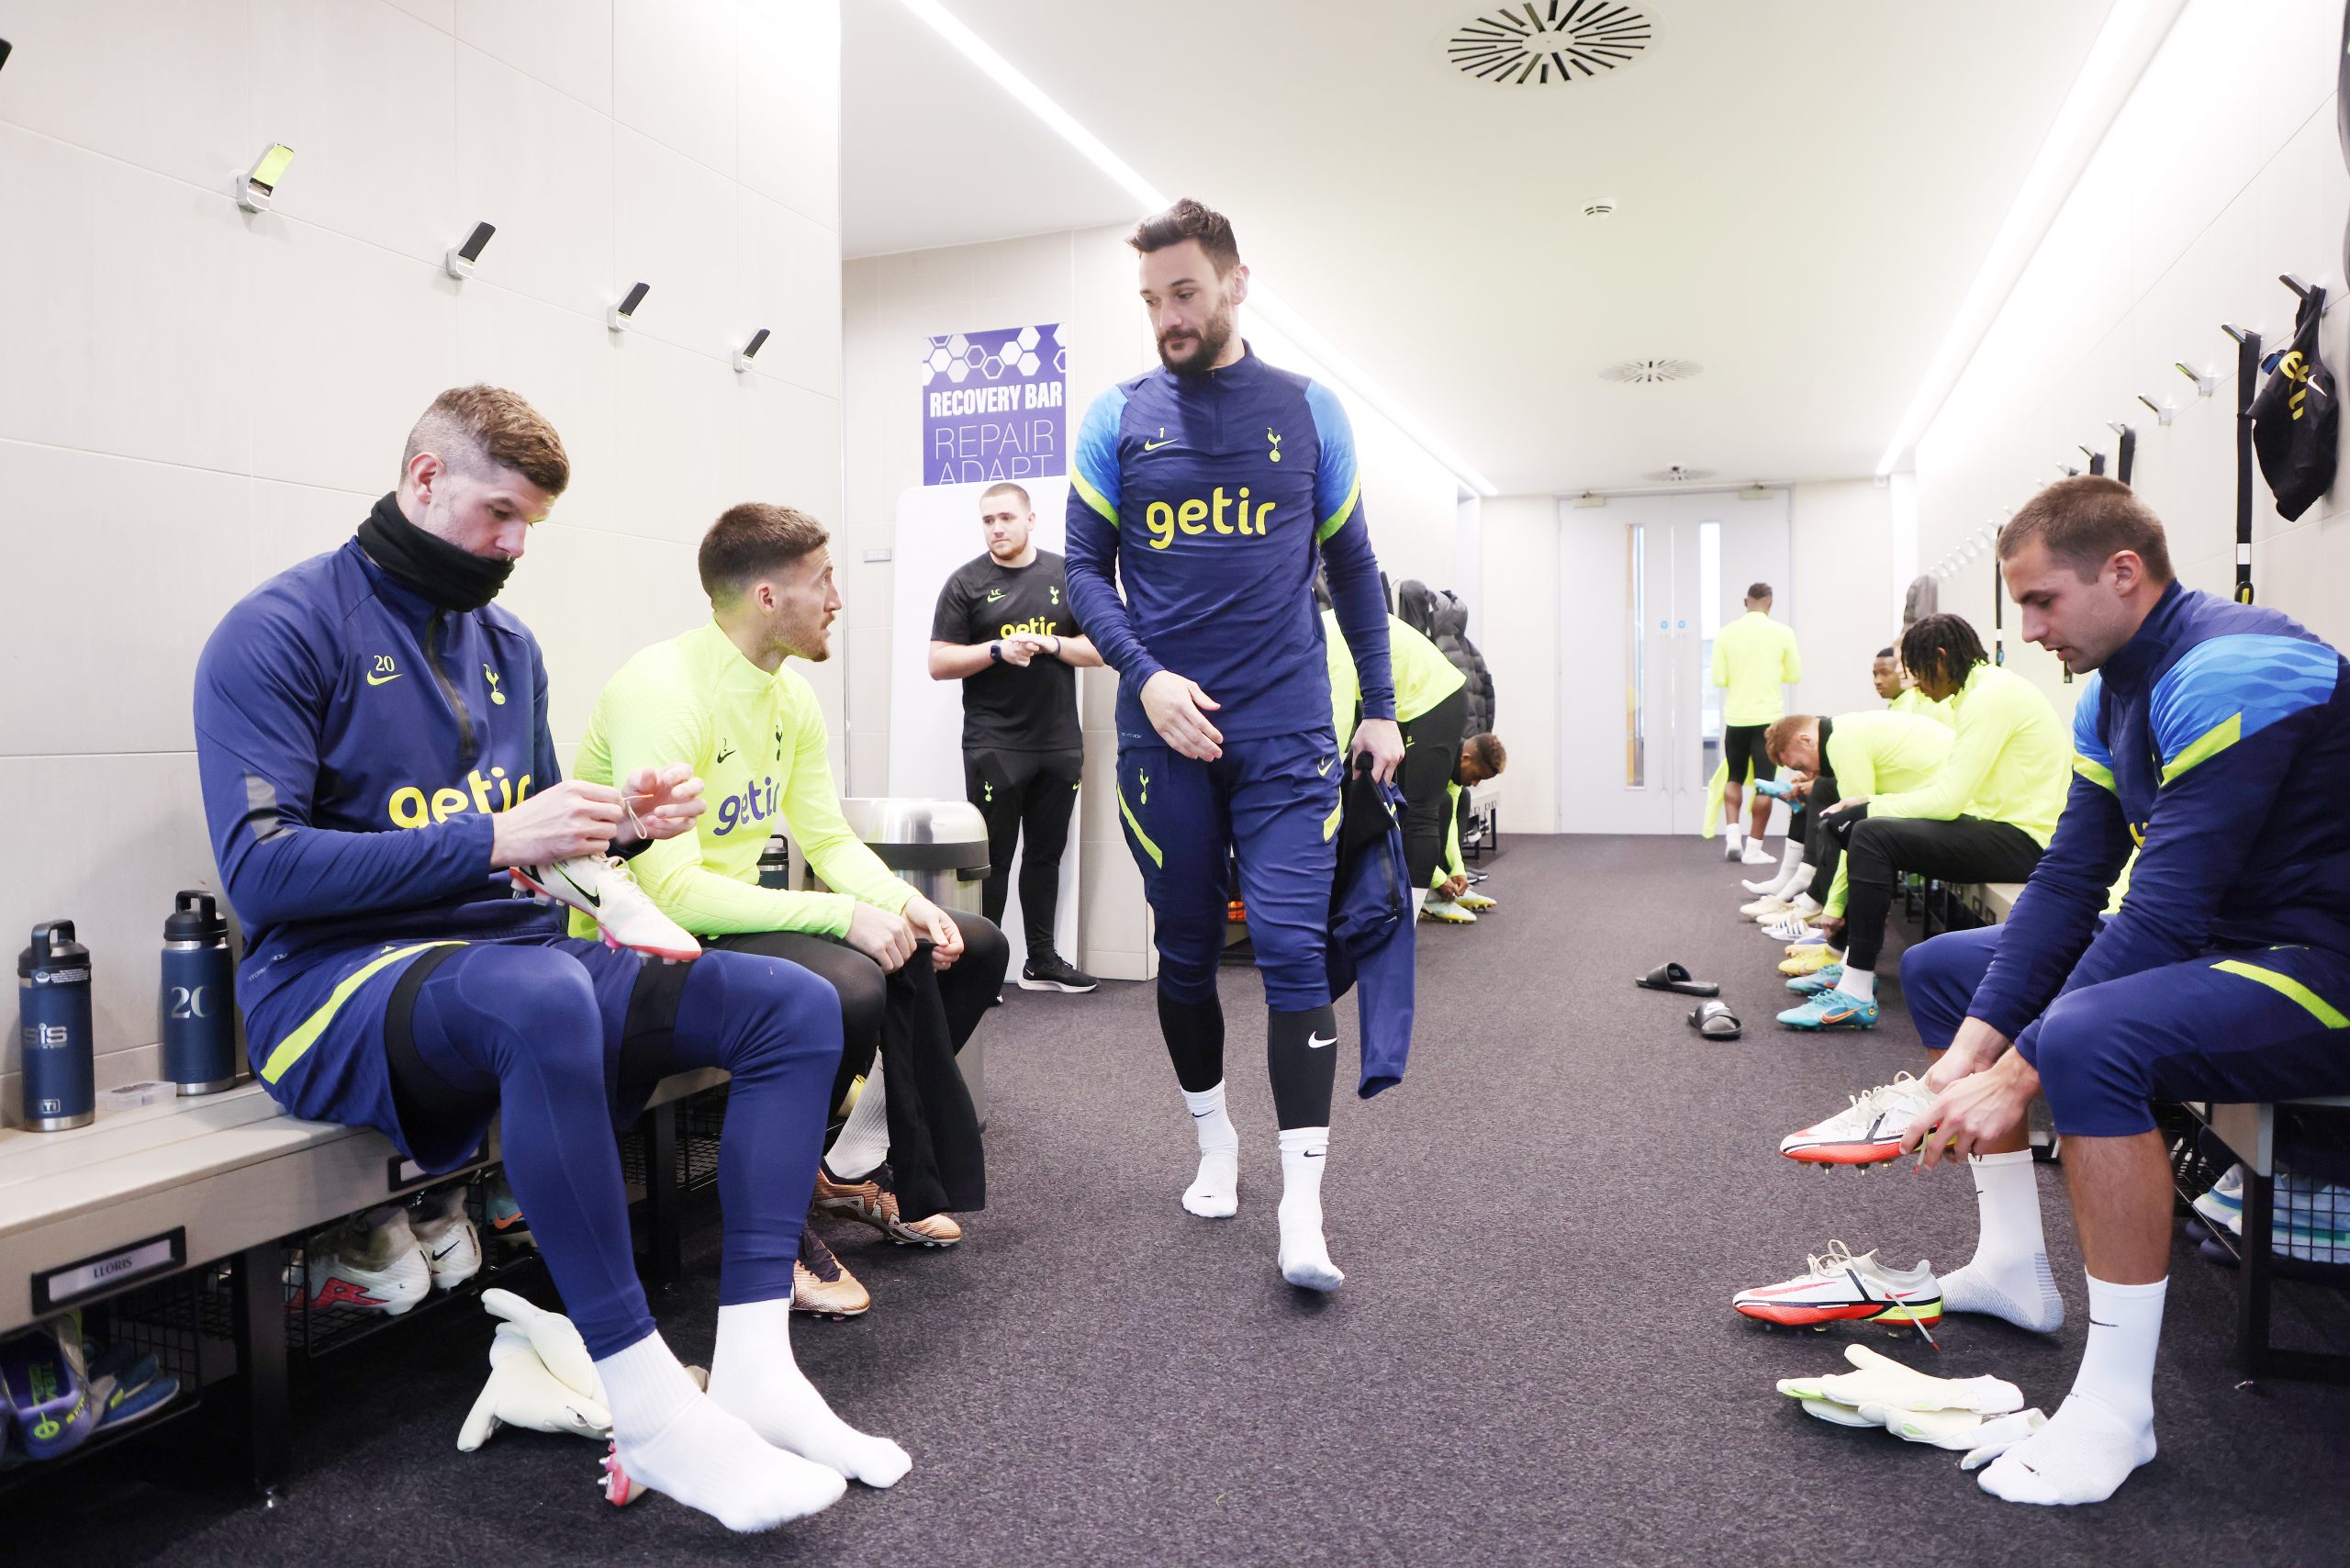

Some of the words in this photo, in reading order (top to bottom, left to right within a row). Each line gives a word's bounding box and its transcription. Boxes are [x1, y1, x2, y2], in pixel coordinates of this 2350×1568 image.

[929, 384, 1022, 418] RECOVERY
[1024, 381, 1063, 409] BAR
[935, 420, 1054, 460] REPAIR
[1158, 427, 1165, 439] 1
[938, 454, 1054, 486] ADAPT
[1146, 487, 1276, 550] getir
[374, 655, 395, 672] 20
[712, 776, 780, 836] getir
[94, 1258, 132, 1279] LLORIS
